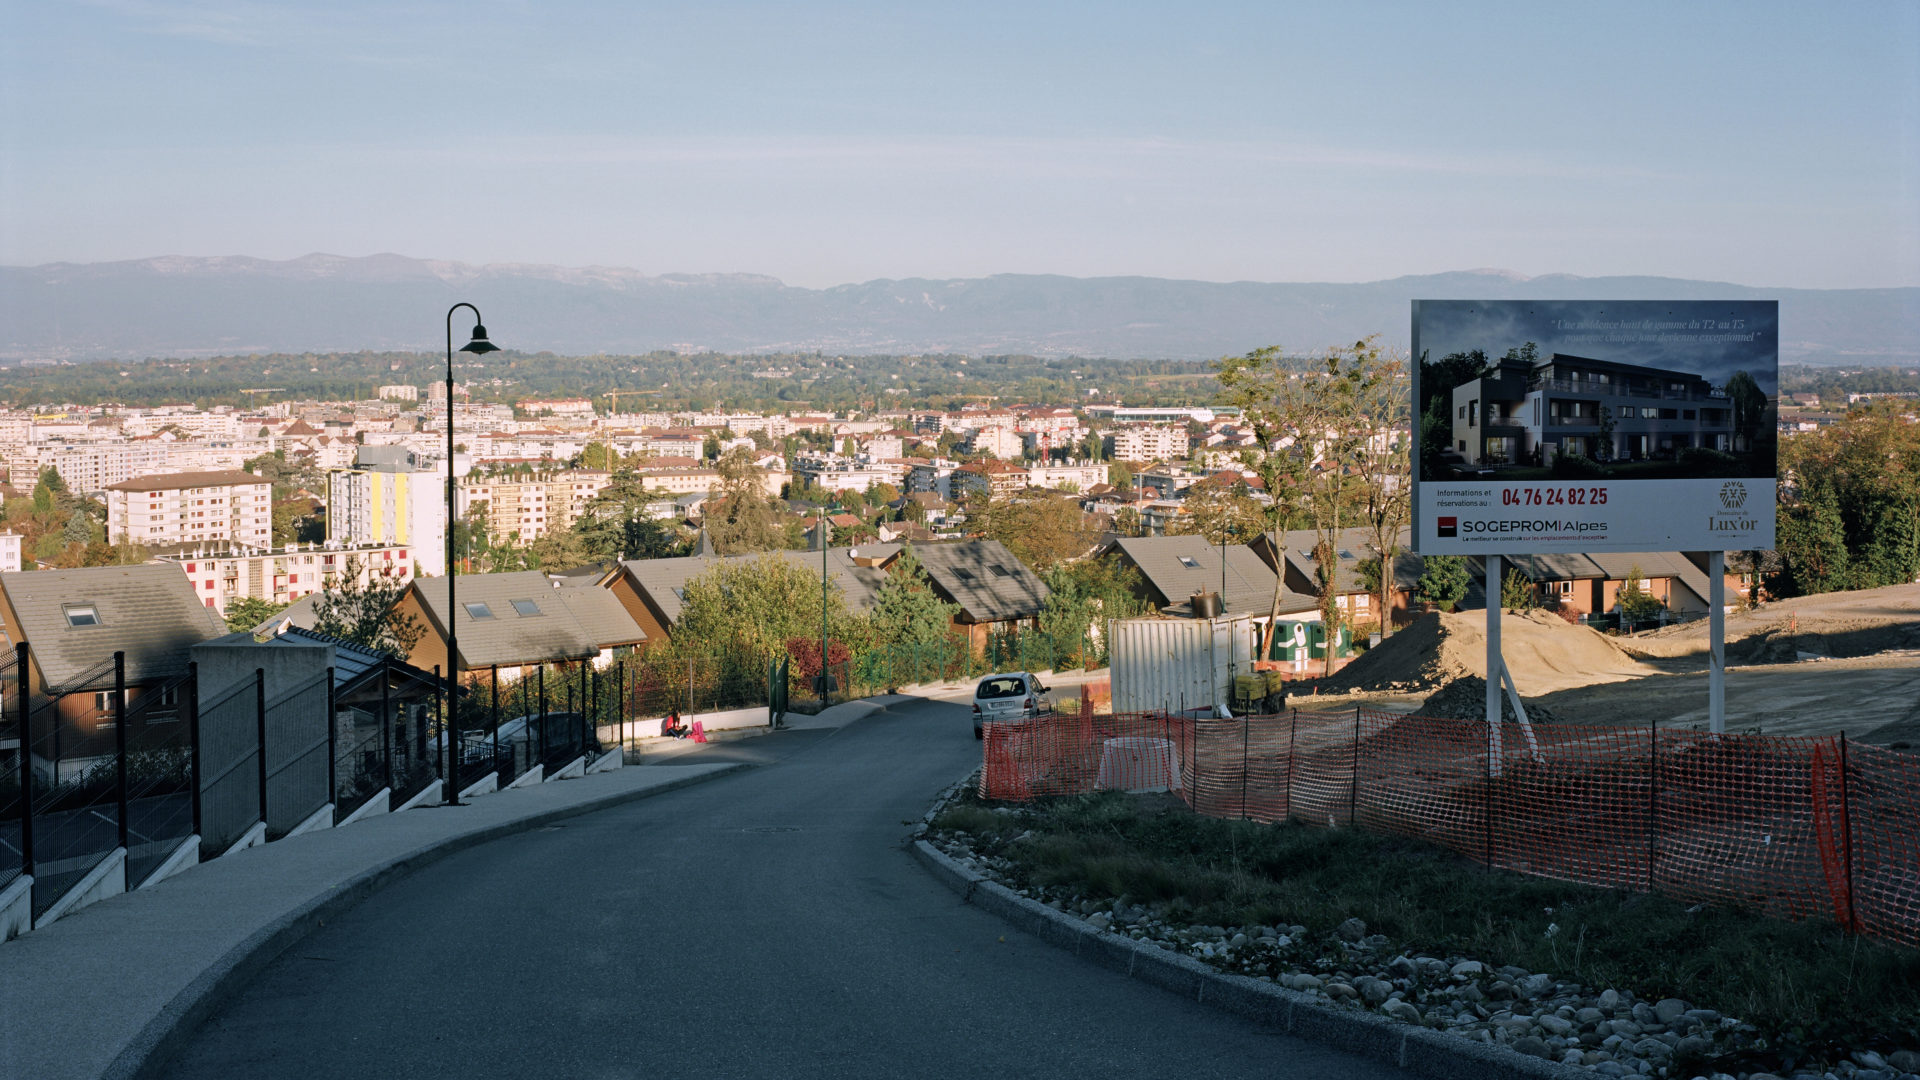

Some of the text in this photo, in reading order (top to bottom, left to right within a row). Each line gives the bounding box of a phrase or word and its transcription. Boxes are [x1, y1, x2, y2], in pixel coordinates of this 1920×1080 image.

[1557, 319, 1576, 330] Une
[1620, 319, 1641, 330] haut
[1642, 319, 1653, 330] de
[1654, 321, 1686, 332] gamme
[1688, 319, 1700, 329] du
[1702, 319, 1715, 330] T2
[1717, 321, 1729, 330] au
[1731, 319, 1744, 330] T5
[1604, 333, 1637, 345] chaque
[1699, 332, 1754, 344] exceptionnel
[1502, 487, 1608, 506] 04 76 24 82 25
[1709, 516, 1758, 531] Lux'or
